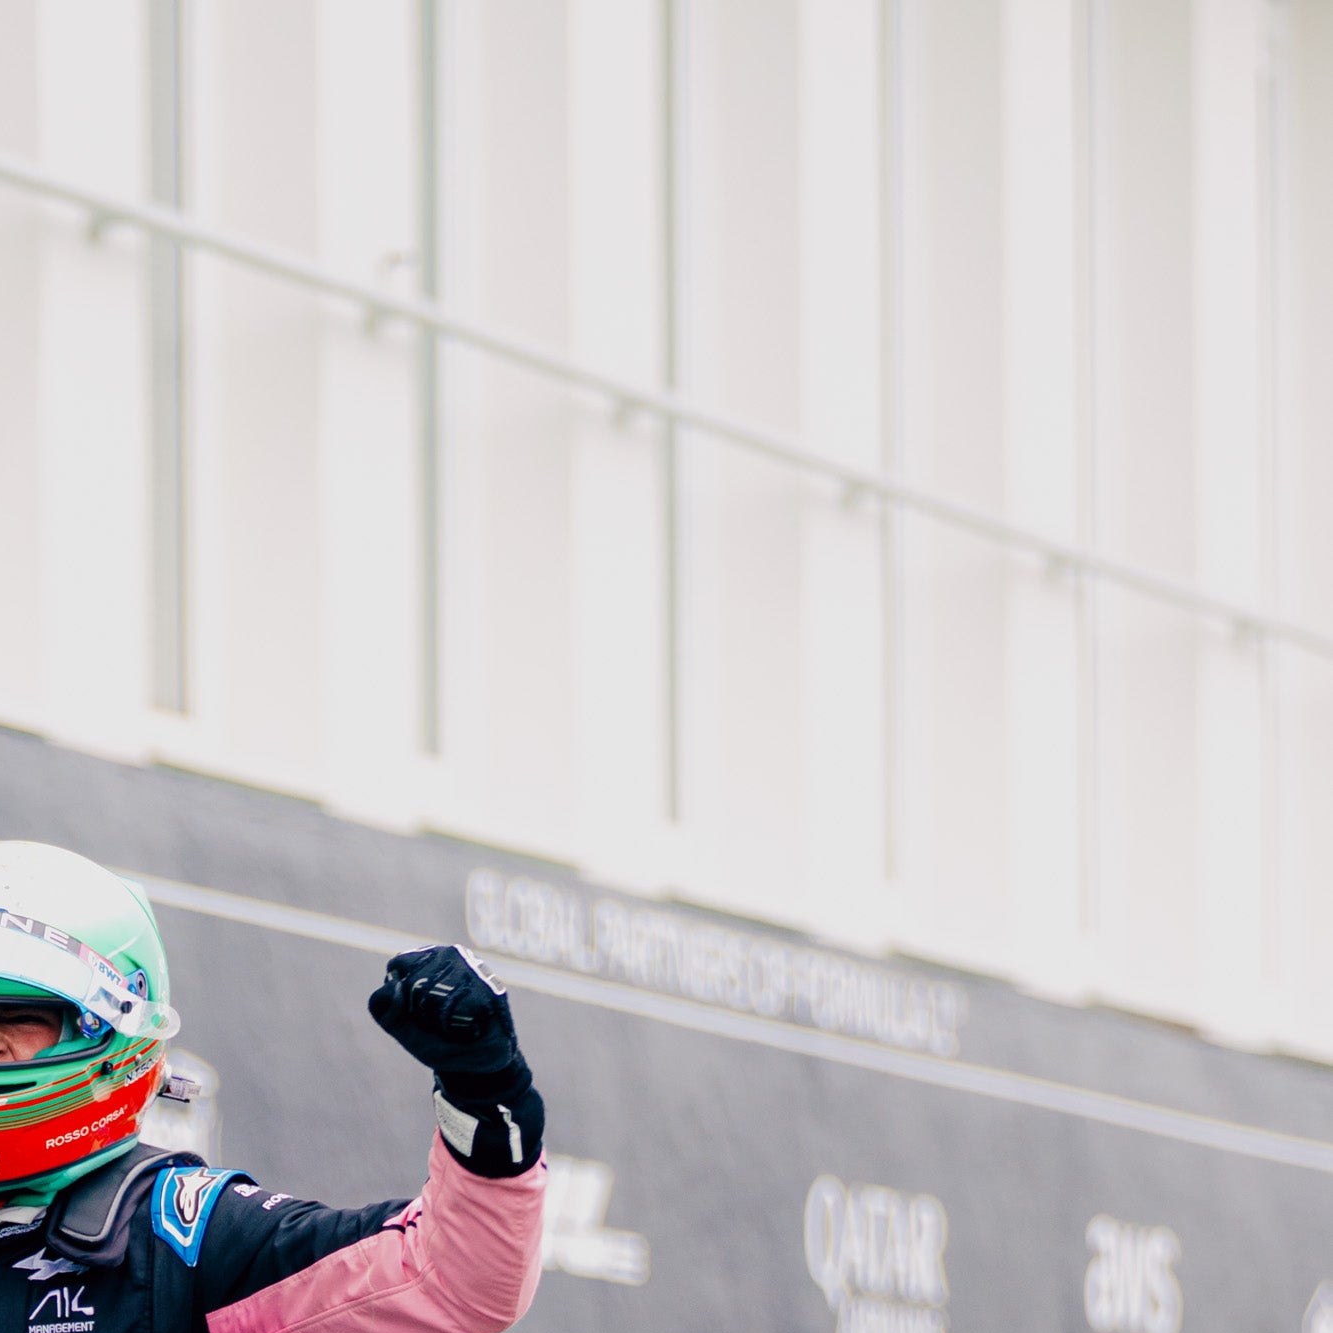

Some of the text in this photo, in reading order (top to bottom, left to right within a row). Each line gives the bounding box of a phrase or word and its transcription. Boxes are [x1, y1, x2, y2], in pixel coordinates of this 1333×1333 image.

[98, 962, 122, 986] BWT
[46, 1125, 89, 1150] ROSSO
[805, 1174, 948, 1308] QATAR
